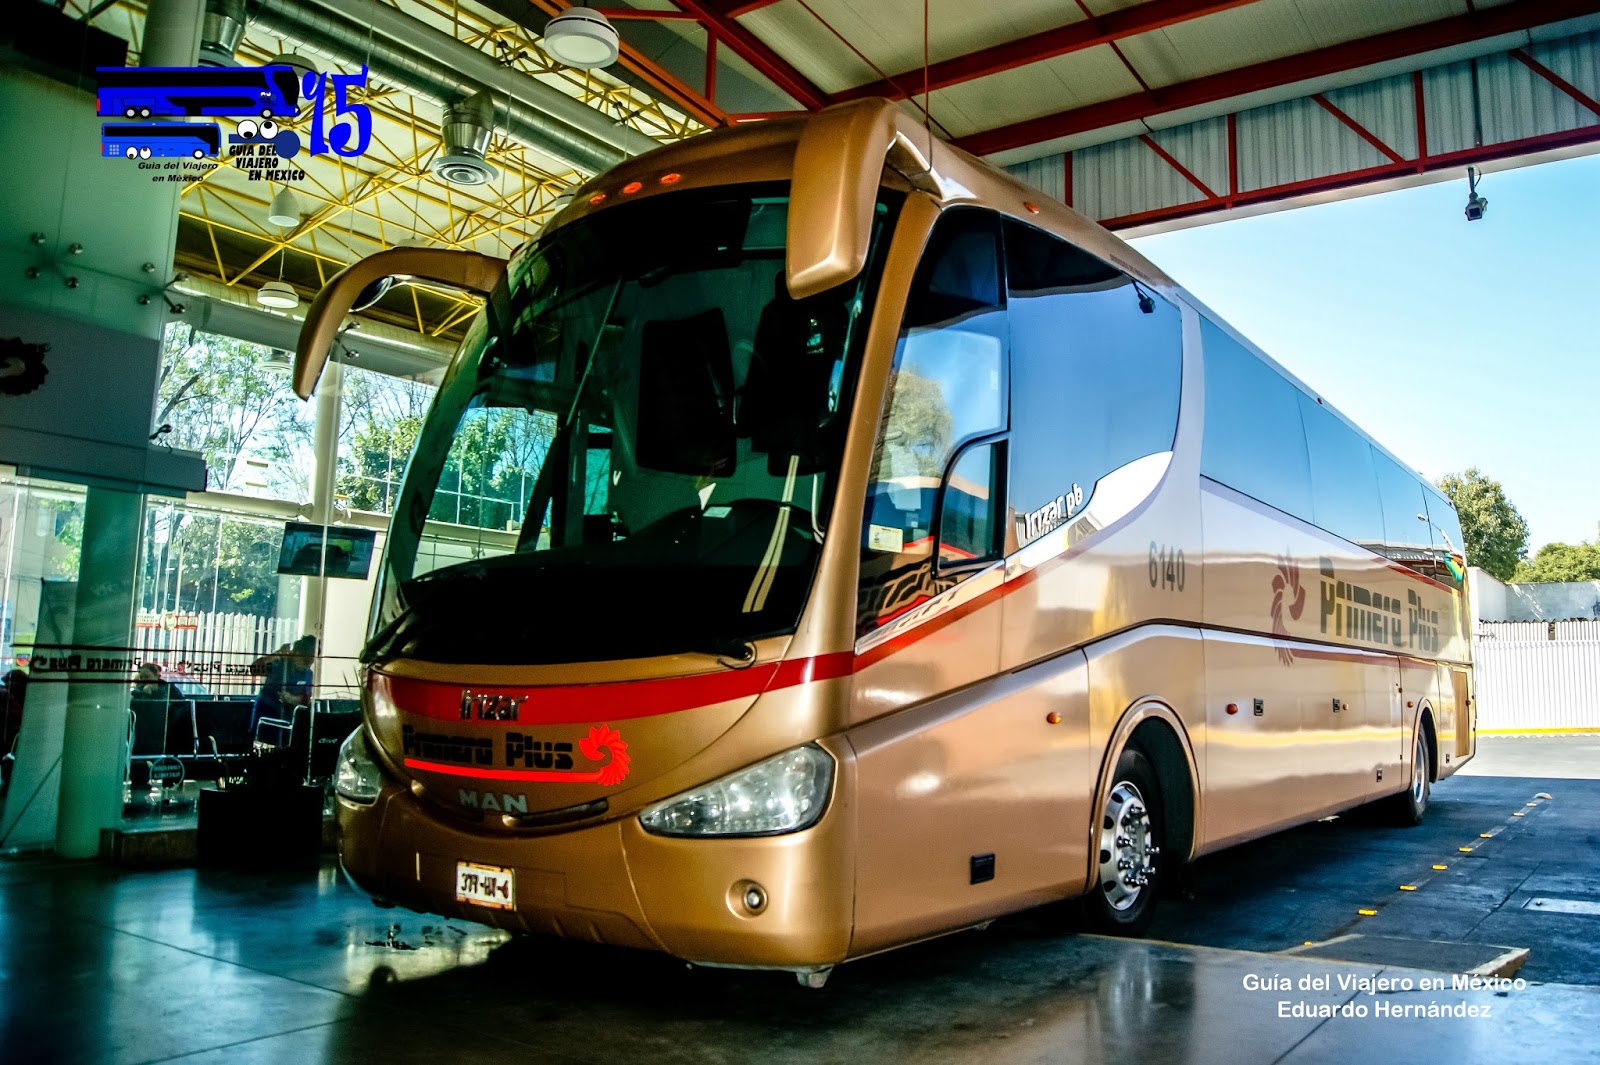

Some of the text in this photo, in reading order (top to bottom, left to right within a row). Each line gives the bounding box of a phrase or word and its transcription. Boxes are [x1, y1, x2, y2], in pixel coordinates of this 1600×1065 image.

[1065, 482, 1084, 519] pb
[1148, 540, 1185, 593] 6140
[1319, 555, 1439, 653] Primera Plus
[402, 724, 573, 770] Primera Plus
[458, 788, 528, 814] MAN
